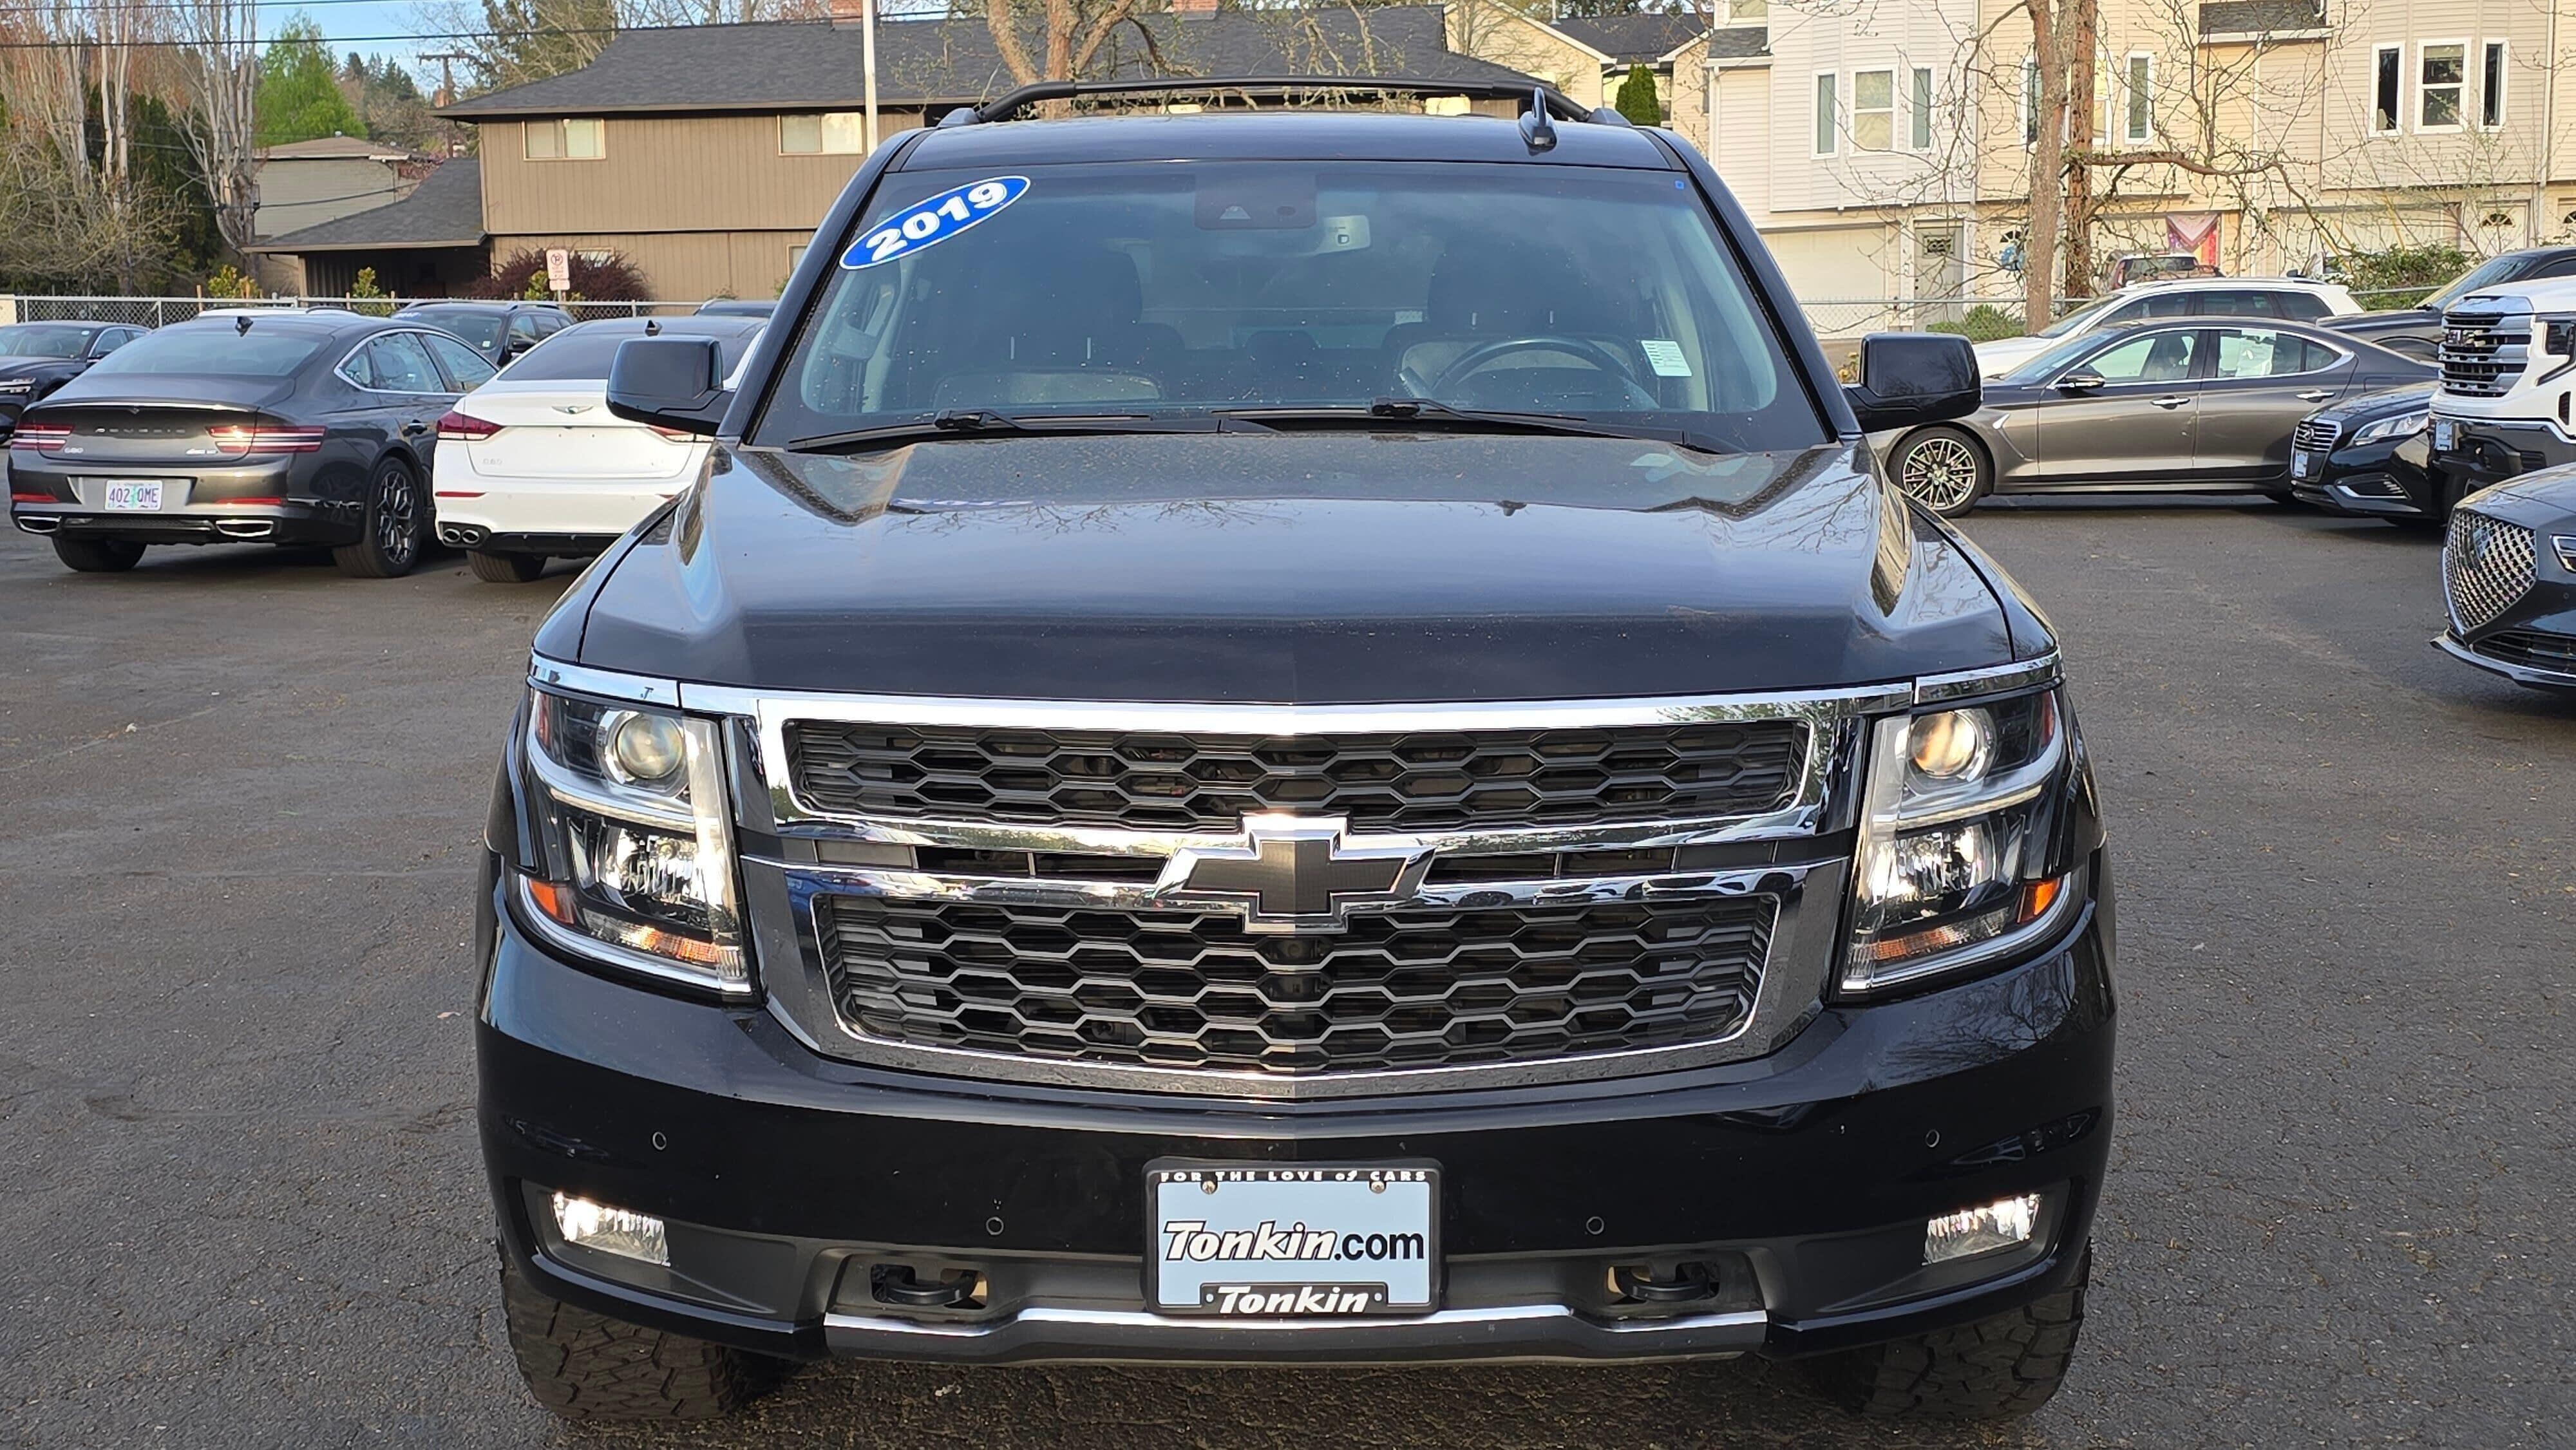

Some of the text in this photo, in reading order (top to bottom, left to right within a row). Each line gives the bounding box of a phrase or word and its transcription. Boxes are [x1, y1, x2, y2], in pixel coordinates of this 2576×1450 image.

[866, 182, 1008, 262] 2019
[109, 487, 130, 503] 402
[1160, 1171, 1202, 1182] FOR
[1215, 1171, 1256, 1182] THE
[1267, 1171, 1323, 1182] LOVE
[1370, 1171, 1426, 1182] CARS
[1163, 1220, 1425, 1261] Tonkin.com
[1217, 1285, 1369, 1314] Tonkin
